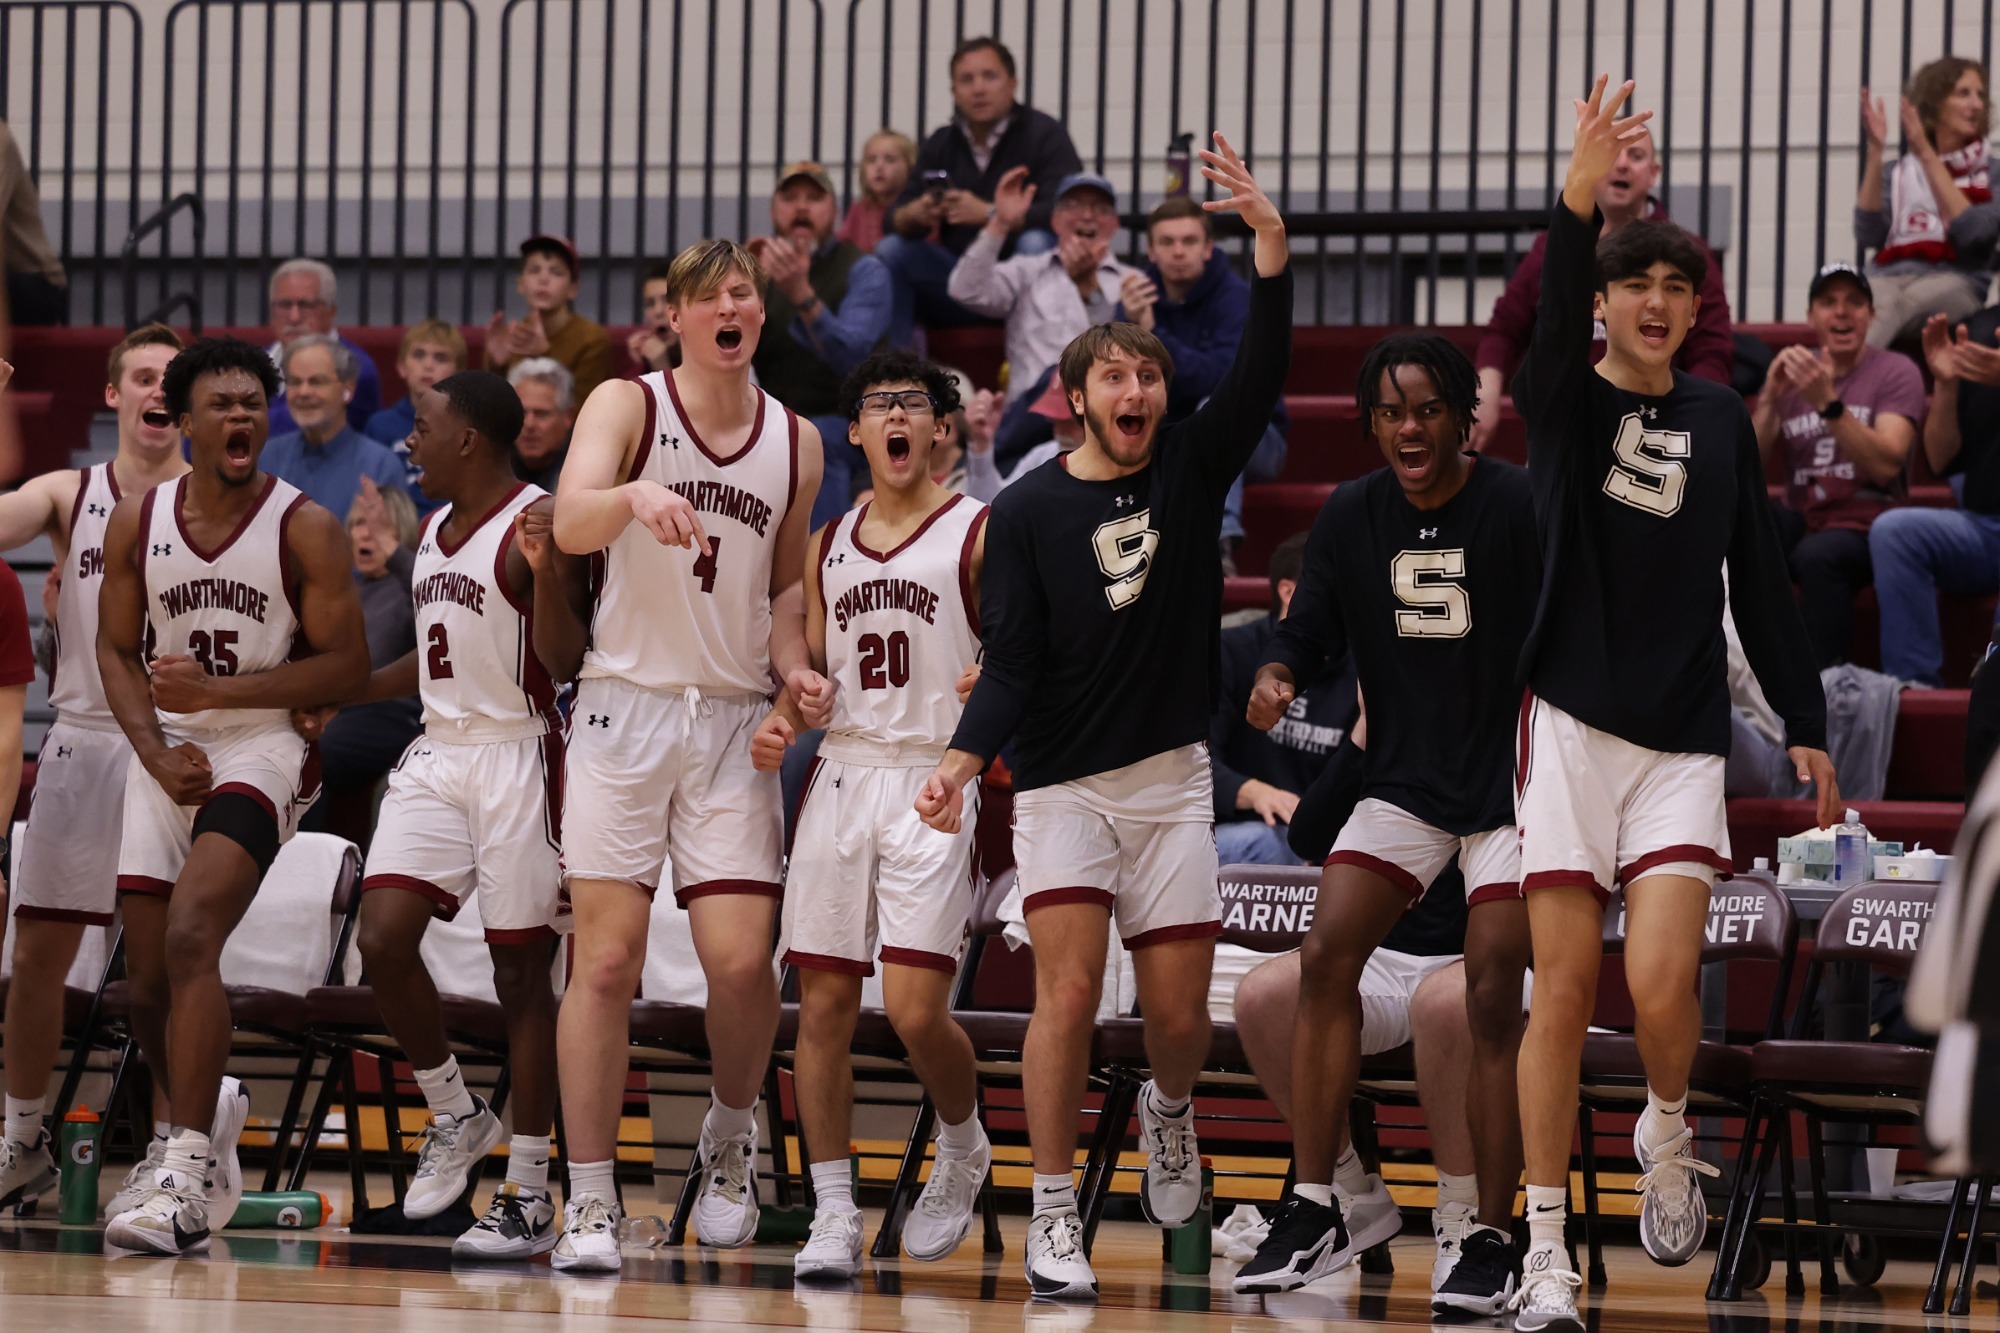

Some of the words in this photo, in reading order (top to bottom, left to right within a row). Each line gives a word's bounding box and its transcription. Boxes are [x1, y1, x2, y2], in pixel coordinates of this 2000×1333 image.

[1602, 412, 1691, 518] S
[664, 480, 772, 539] ARTHMORE
[79, 547, 105, 579] SW
[692, 535, 721, 594] 4
[1091, 507, 1160, 611] S
[413, 572, 486, 618] WARTHMORE
[834, 578, 940, 633] SWARTHMORE
[1390, 548, 1472, 638] S
[188, 629, 239, 677] 35
[427, 622, 454, 680] 2
[857, 630, 910, 691] 20
[1220, 882, 1319, 902] WARTHMO
[1851, 897, 1937, 919] SWARTH
[1220, 901, 1316, 933] ARNE
[1704, 914, 1763, 944] NET
[1845, 916, 1921, 951] GAR
[71, 1139, 94, 1165] G
